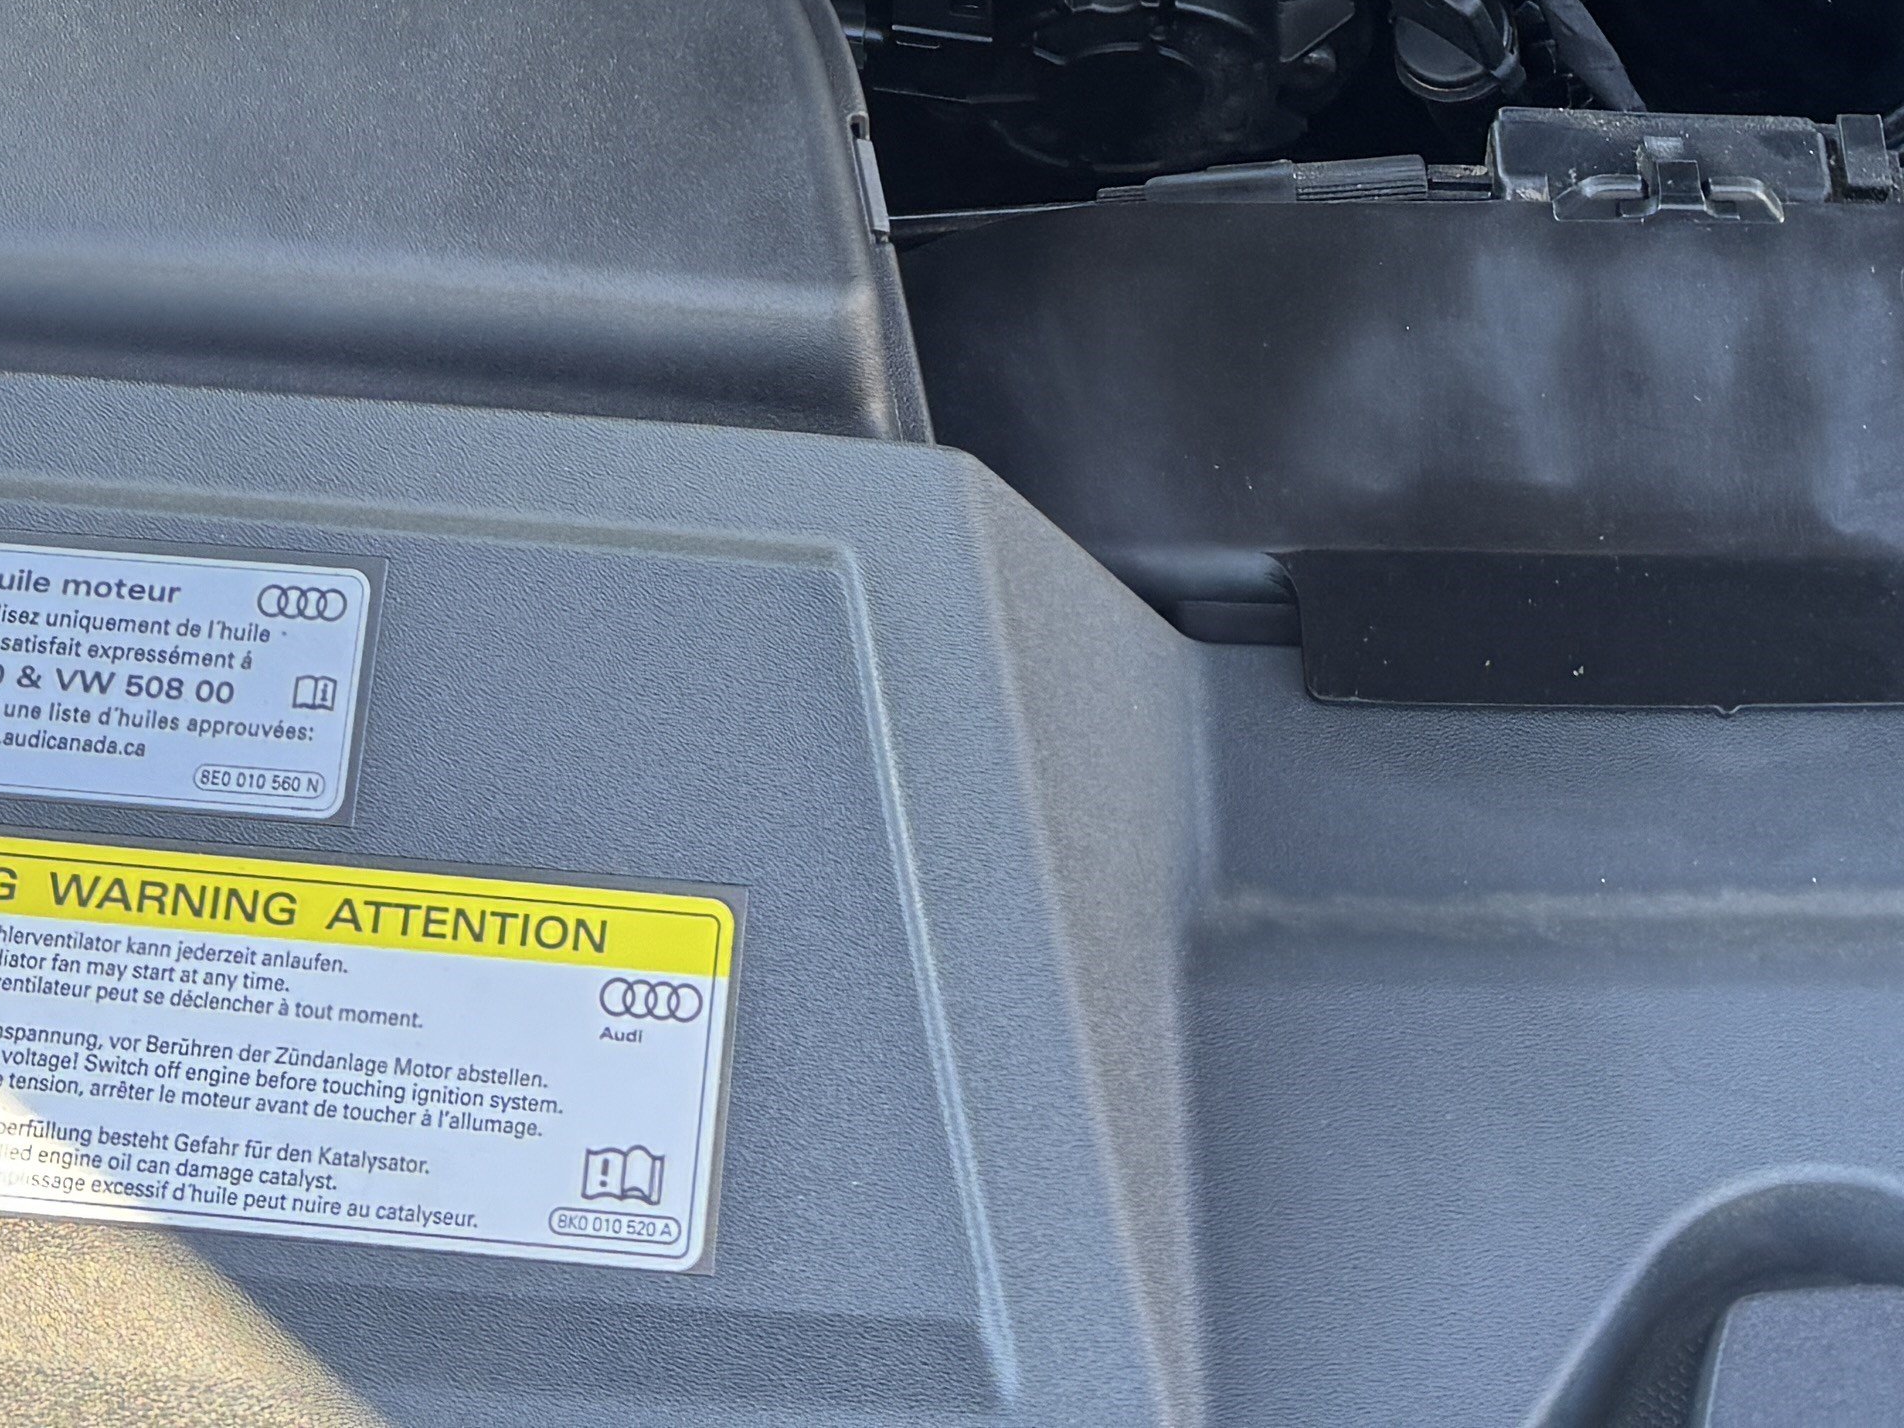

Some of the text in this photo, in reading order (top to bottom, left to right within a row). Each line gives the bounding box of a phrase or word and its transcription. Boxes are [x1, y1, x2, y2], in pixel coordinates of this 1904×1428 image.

[61, 578, 181, 603] moteur
[45, 609, 171, 636] uniquement
[175, 617, 202, 638] de
[0, 634, 82, 658] satisfait
[87, 643, 235, 670] expressément
[16, 664, 42, 689] &
[55, 667, 116, 695] VW
[124, 674, 184, 700] 508
[195, 679, 235, 705] 00
[3, 703, 42, 720] une
[48, 702, 91, 724] liste
[186, 717, 314, 741] approuvées:
[199, 769, 319, 793] 8E0 010 560 N
[49, 871, 297, 926] WARNING
[324, 897, 607, 954] ATTENTION
[51, 952, 81, 974] fan
[86, 960, 128, 982] may
[131, 963, 176, 983] start
[179, 968, 199, 985] at
[202, 971, 238, 992] any
[242, 970, 289, 992] time.
[125, 935, 172, 958] kann
[174, 940, 257, 966] jederzeit
[260, 949, 348, 973] anlaufen.
[95, 985, 139, 1004] peut
[142, 989, 165, 1005] se
[169, 988, 274, 1015] déclencher
[294, 1001, 333, 1021] tout
[338, 1007, 423, 1028] moment.
[598, 1026, 643, 1043] Audi
[1, 1047, 79, 1073] voltage!
[83, 1053, 149, 1077] Switch
[154, 1060, 182, 1080] off
[185, 1065, 251, 1087] engine
[255, 1068, 317, 1092] before
[322, 1077, 406, 1104] touching
[411, 1082, 484, 1107] ignition
[489, 1094, 563, 1114] system.
[109, 1035, 142, 1053] vor
[145, 1033, 233, 1060] Berühren
[237, 1043, 272, 1063] der
[273, 1046, 388, 1077] Zündanlage
[393, 1056, 453, 1080] Motor
[456, 1063, 548, 1088] abstellen.
[8, 1072, 84, 1097] tension,
[89, 1080, 155, 1101] arrêter
[158, 1083, 176, 1103] le
[181, 1090, 251, 1110] moteur
[255, 1097, 309, 1116] avant
[313, 1098, 337, 1118] de
[342, 1103, 417, 1125] toucher
[97, 1125, 169, 1151] besteht
[174, 1132, 240, 1156] Gefahr
[244, 1139, 272, 1159] für
[276, 1142, 312, 1163] den
[318, 1145, 429, 1174] Katalysator.
[38, 1147, 103, 1169] engine
[107, 1152, 132, 1171] oil
[136, 1158, 170, 1175] can
[174, 1158, 254, 1186] damage
[258, 1168, 337, 1193] catalyst.
[91, 1179, 170, 1199] excessif
[242, 1193, 288, 1211] peut
[291, 1194, 341, 1216] nuire
[346, 1202, 370, 1218] au
[375, 1204, 478, 1228] catalyseur.
[557, 1213, 672, 1237] 8K0 010 520 A
